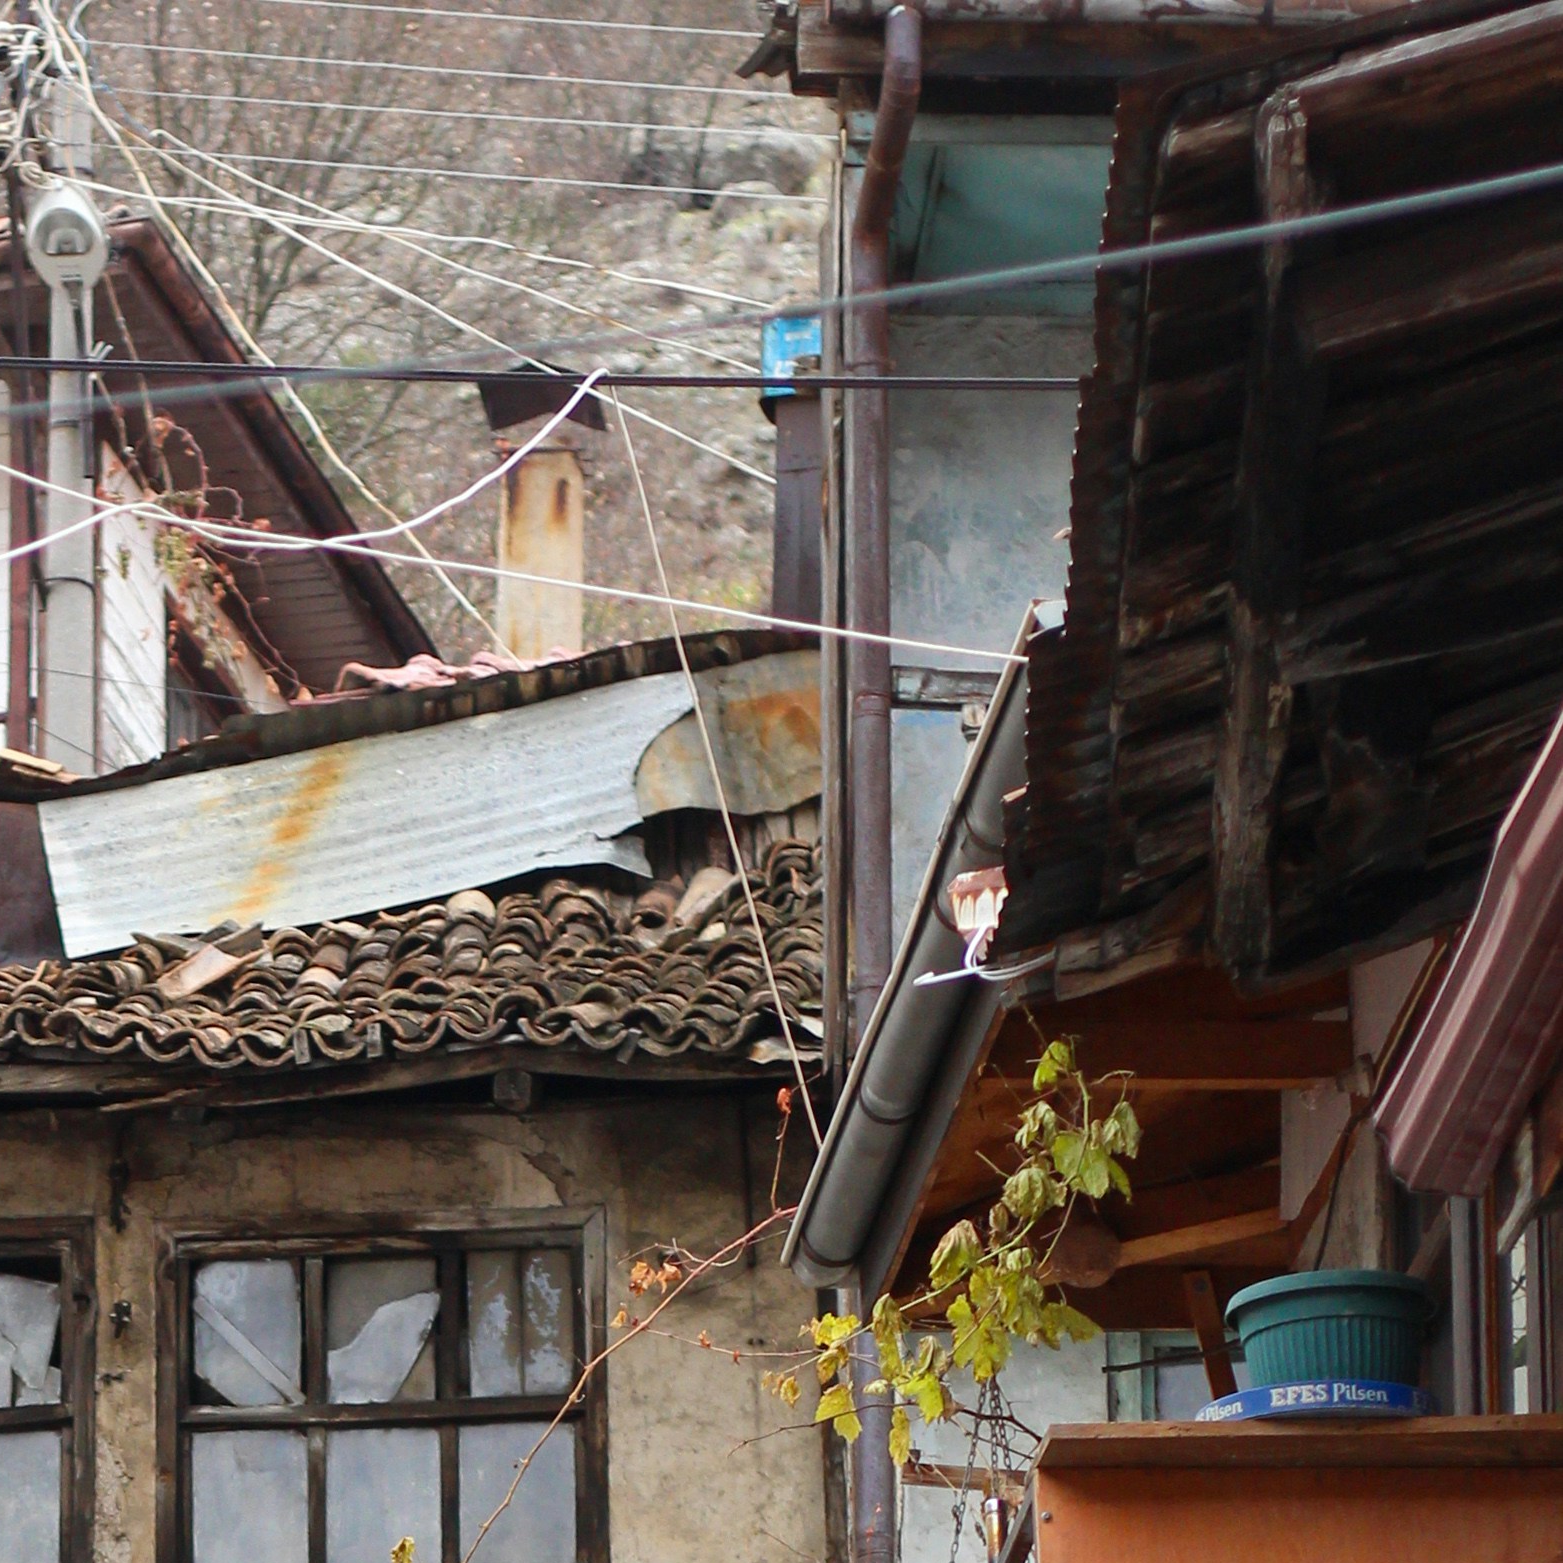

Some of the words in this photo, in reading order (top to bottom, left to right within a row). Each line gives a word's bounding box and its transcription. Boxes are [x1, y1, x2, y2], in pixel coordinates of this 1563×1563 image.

[1269, 1383, 1328, 1408] EFES
[1331, 1381, 1389, 1403] Pilsen
[1205, 1401, 1244, 1422] Pilsen
